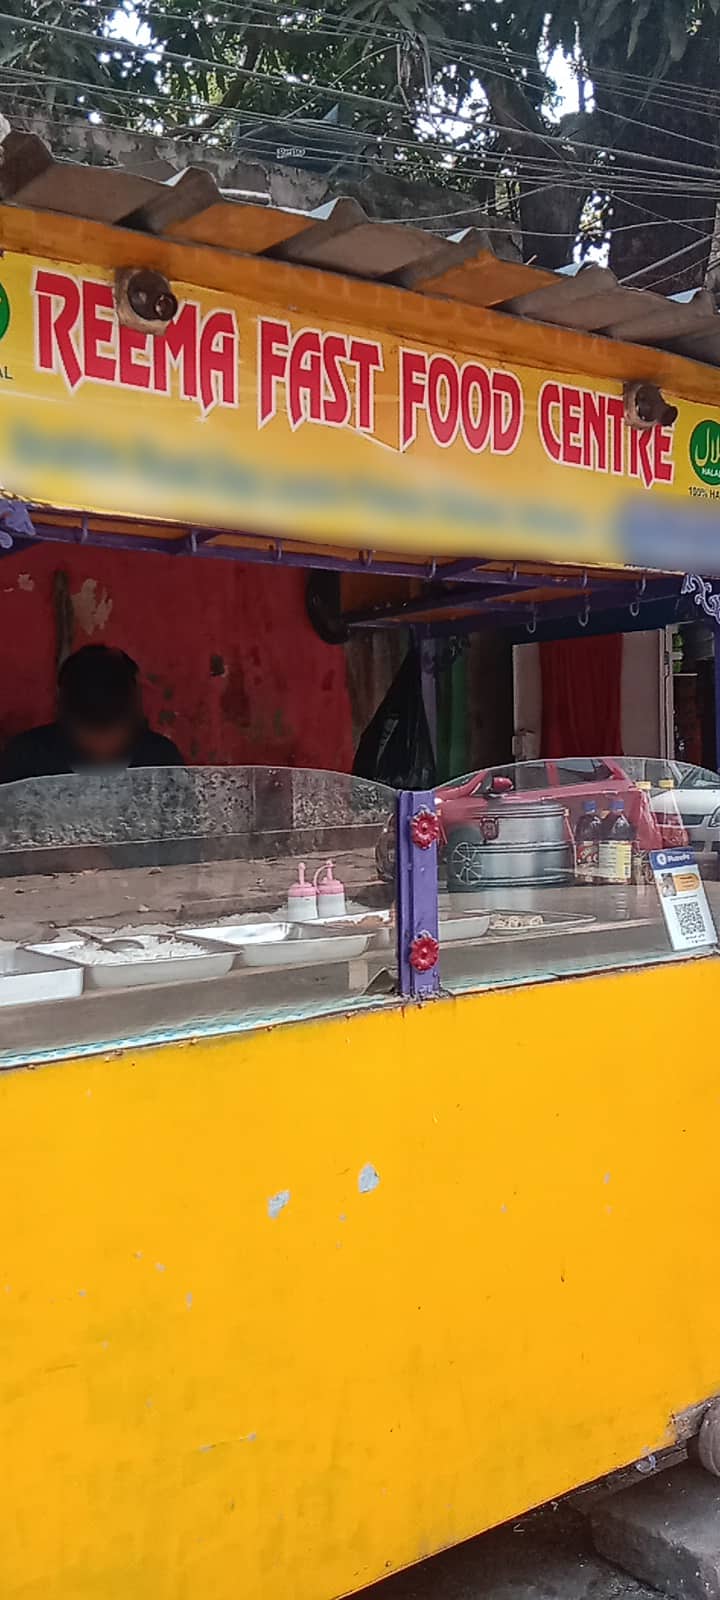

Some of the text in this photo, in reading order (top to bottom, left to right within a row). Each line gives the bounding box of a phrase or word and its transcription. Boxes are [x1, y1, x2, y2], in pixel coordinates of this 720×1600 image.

[33, 268, 674, 488] REEMA FAST FOOD CENTRE
